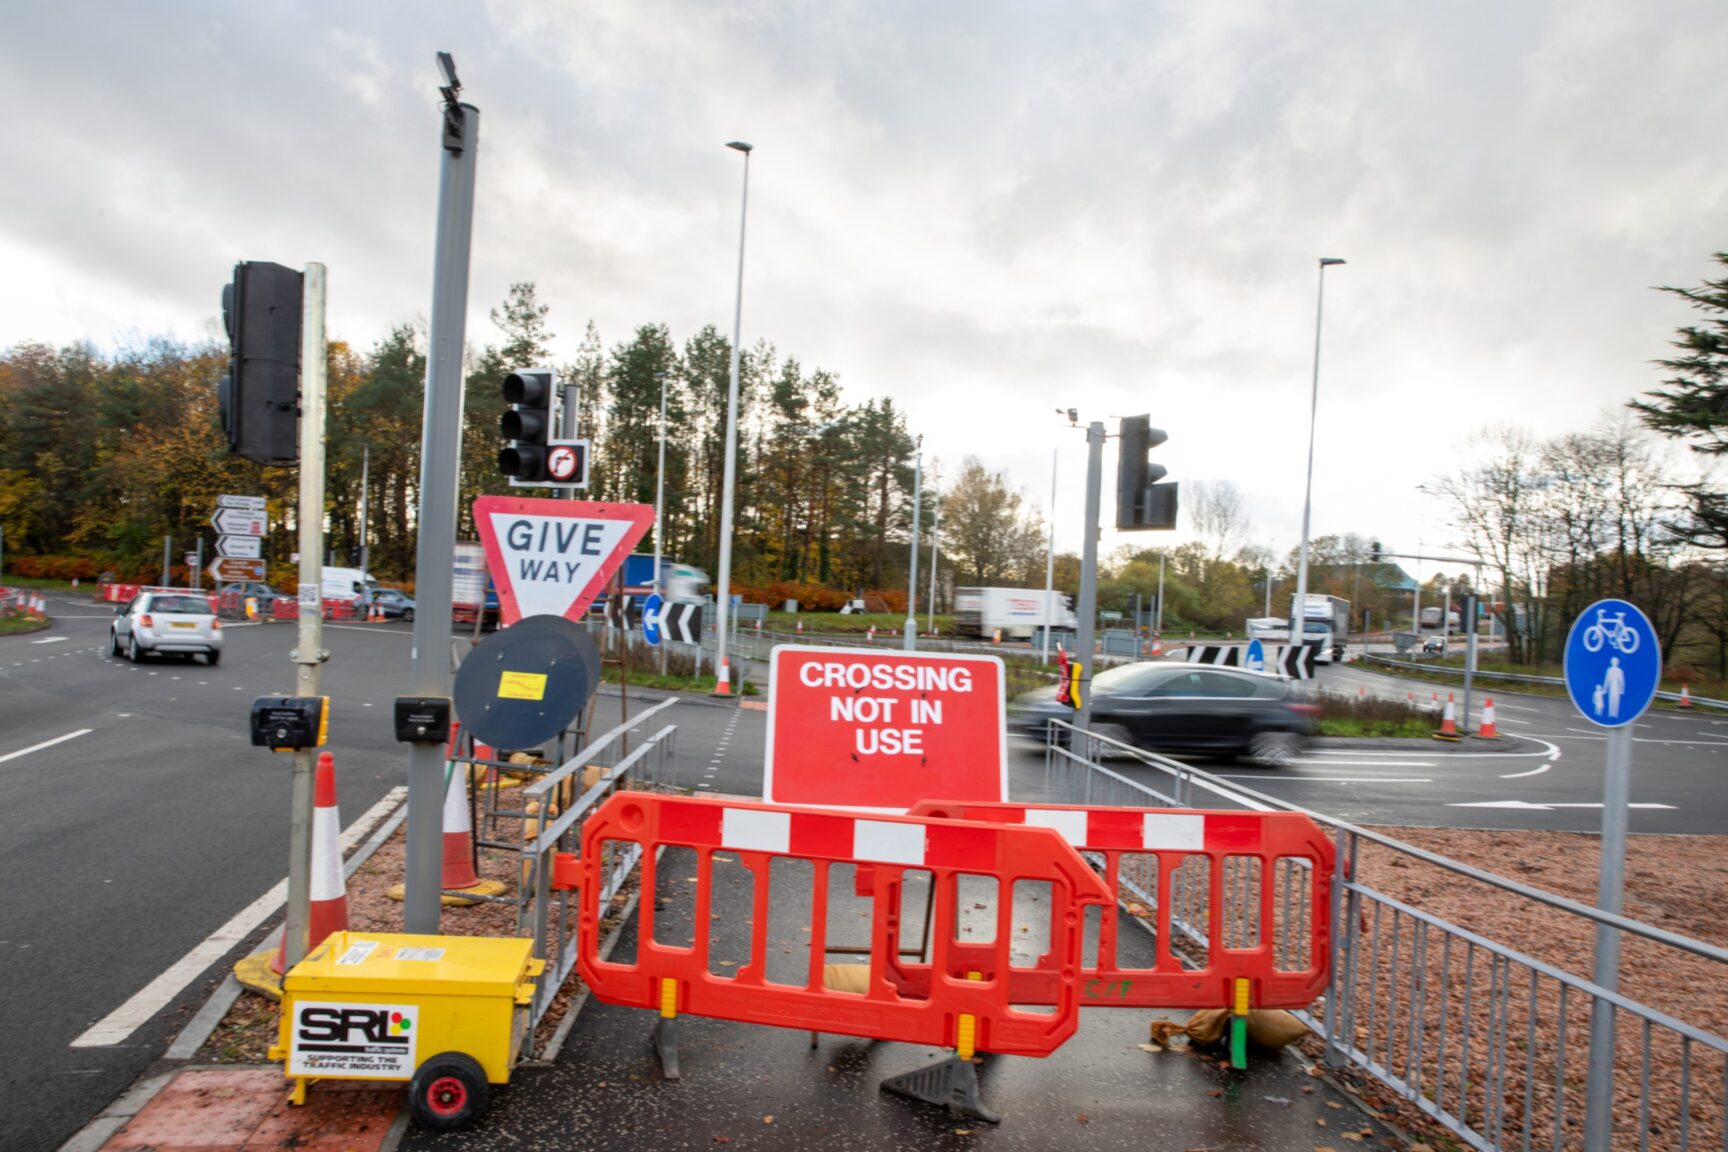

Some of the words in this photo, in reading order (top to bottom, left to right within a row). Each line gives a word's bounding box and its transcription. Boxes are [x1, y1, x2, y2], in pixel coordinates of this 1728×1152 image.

[507, 519, 604, 556] GIVE
[520, 558, 581, 583] WAY
[799, 661, 973, 692] CROSSING
[830, 696, 898, 722] NOT
[910, 699, 942, 724] IN
[855, 728, 924, 754] USE
[299, 1007, 409, 1044] SRL
[303, 1061, 347, 1070] TRAFFIC
[348, 1062, 402, 1071] INDUSTRY
[307, 1054, 374, 1063] SUPPORTING
[378, 1056, 399, 1064] THE
